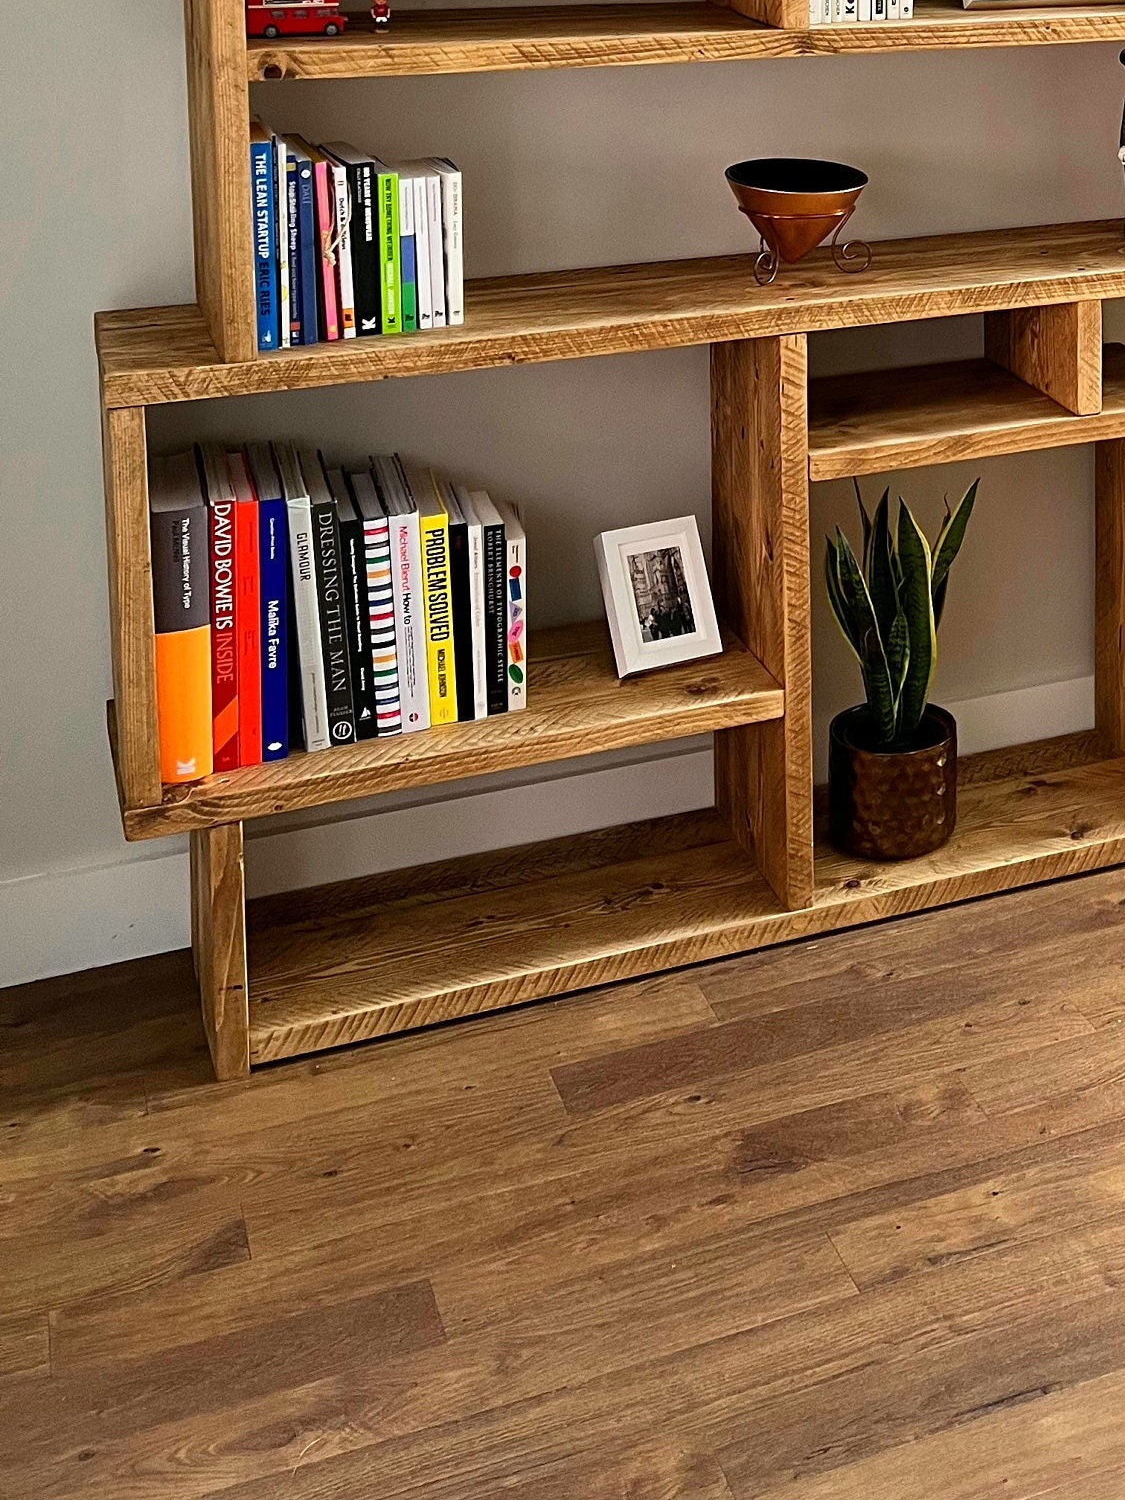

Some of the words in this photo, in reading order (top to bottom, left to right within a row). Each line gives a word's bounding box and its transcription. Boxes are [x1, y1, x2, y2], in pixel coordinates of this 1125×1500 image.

[255, 153, 267, 175] THE
[256, 178, 268, 207] LEAN
[257, 210, 271, 258] STARTUP
[290, 228, 298, 251] Sheep
[258, 261, 270, 287] ERIC
[259, 290, 271, 316] RIES
[181, 518, 190, 532] The
[214, 504, 233, 556] DAVID
[181, 533, 191, 556] Visual
[296, 532, 311, 581] GLAMOUR
[318, 512, 339, 602] DRESSING
[398, 526, 410, 562] Michael
[181, 556, 191, 582] History
[424, 528, 447, 590] PROBLEM
[183, 582, 191, 591] of
[215, 559, 233, 614] BOWIE
[400, 563, 411, 591] Bierut
[487, 563, 495, 614] BRINGHURST
[181, 591, 191, 609] Type
[401, 592, 412, 614] How
[496, 589, 503, 599] OF
[216, 616, 233, 630] IS
[267, 600, 280, 636] Malika
[326, 604, 343, 645] THE
[402, 615, 413, 625] to
[426, 592, 450, 641] SOLVED
[496, 601, 504, 657] TYPOGRAPHIC
[216, 633, 234, 684] INSIDE
[268, 638, 280, 669] Favre
[437, 648, 446, 672] MICHAEL
[329, 649, 347, 692] MAN
[438, 673, 447, 698] JOHNSON
